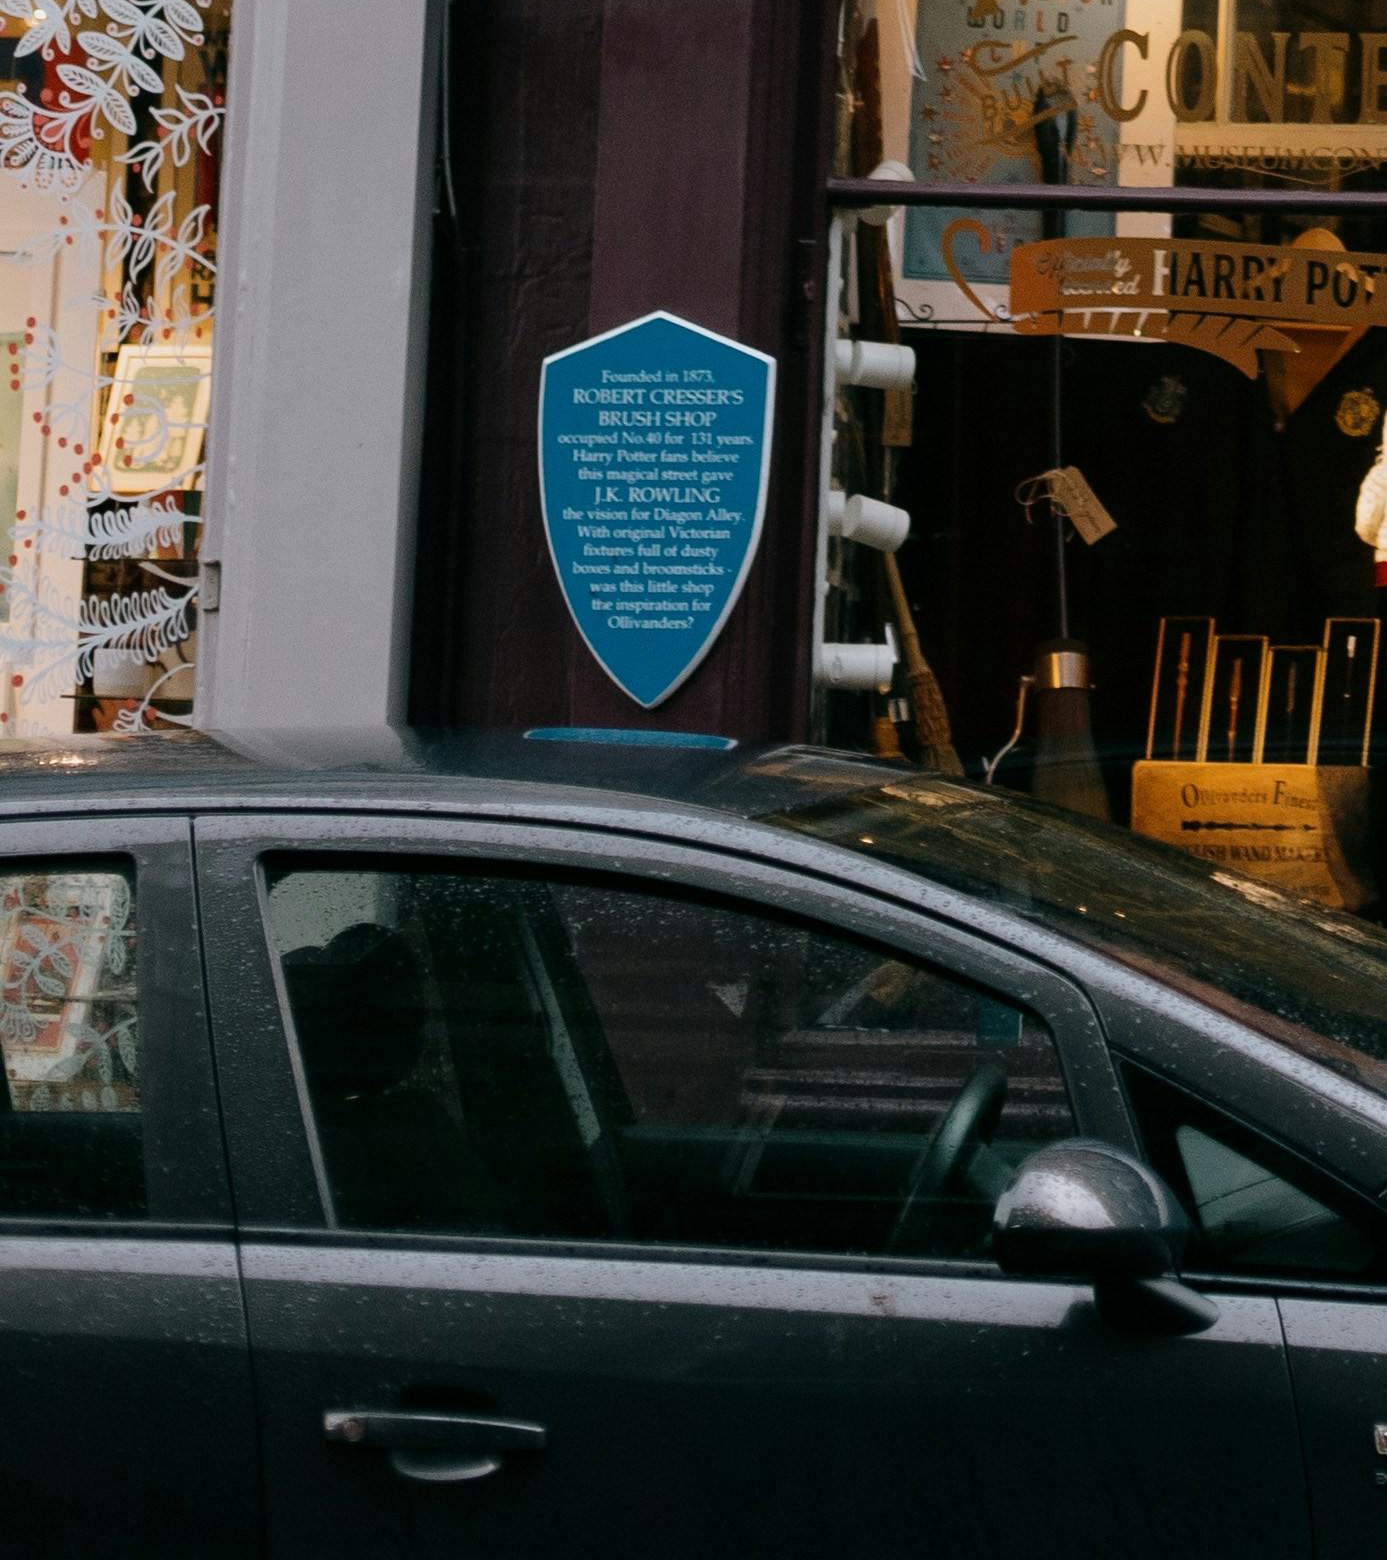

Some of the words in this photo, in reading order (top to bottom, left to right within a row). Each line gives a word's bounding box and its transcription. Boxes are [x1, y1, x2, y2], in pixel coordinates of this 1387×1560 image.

[1153, 248, 1289, 303] HARRY
[602, 370, 662, 383] Founded
[573, 388, 646, 404] ROBERT
[650, 388, 743, 405] CRESSER'S
[598, 411, 661, 426] BRUSH
[665, 411, 717, 427] SHOP
[558, 432, 618, 448] occupied
[665, 432, 684, 445] for
[573, 449, 613, 466] Harry
[617, 449, 658, 463] Potter
[660, 449, 688, 463] fans
[692, 450, 739, 463] believe
[578, 467, 603, 481] this
[606, 467, 659, 484] magical
[661, 468, 698, 481] street
[701, 471, 734, 484] gave
[594, 487, 623, 505] J.K.
[628, 487, 720, 503] ROWLING
[587, 508, 628, 520] vision
[654, 508, 702, 524] Diagon
[577, 526, 611, 538] With
[613, 526, 665, 542] original
[669, 526, 730, 539] Victorian
[584, 544, 634, 557] fixtures
[681, 545, 718, 560] dusty
[643, 562, 724, 575] broomsticks
[616, 599, 689, 614] inspiration
